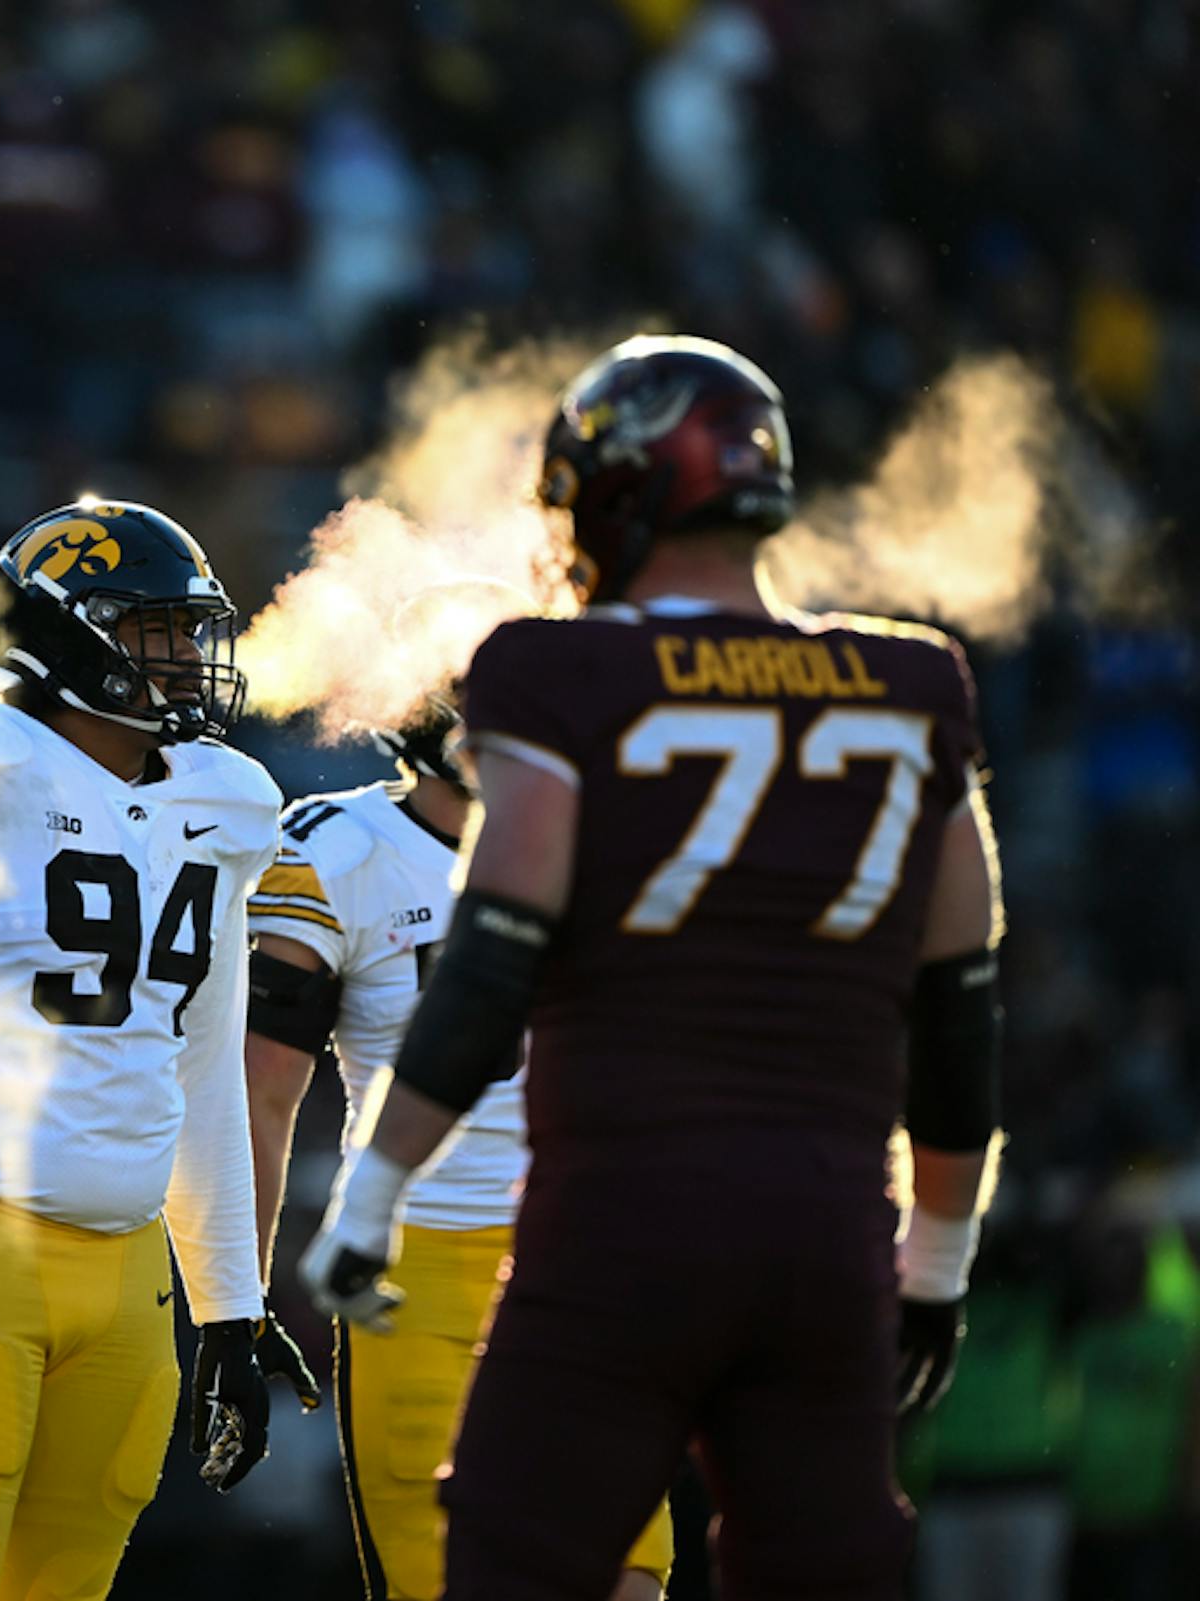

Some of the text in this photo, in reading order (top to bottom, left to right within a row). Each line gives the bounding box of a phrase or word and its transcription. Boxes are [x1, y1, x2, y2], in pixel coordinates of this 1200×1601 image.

[654, 635, 887, 697] CARROLL
[618, 705, 934, 940] 77
[32, 849, 218, 1036] 94
